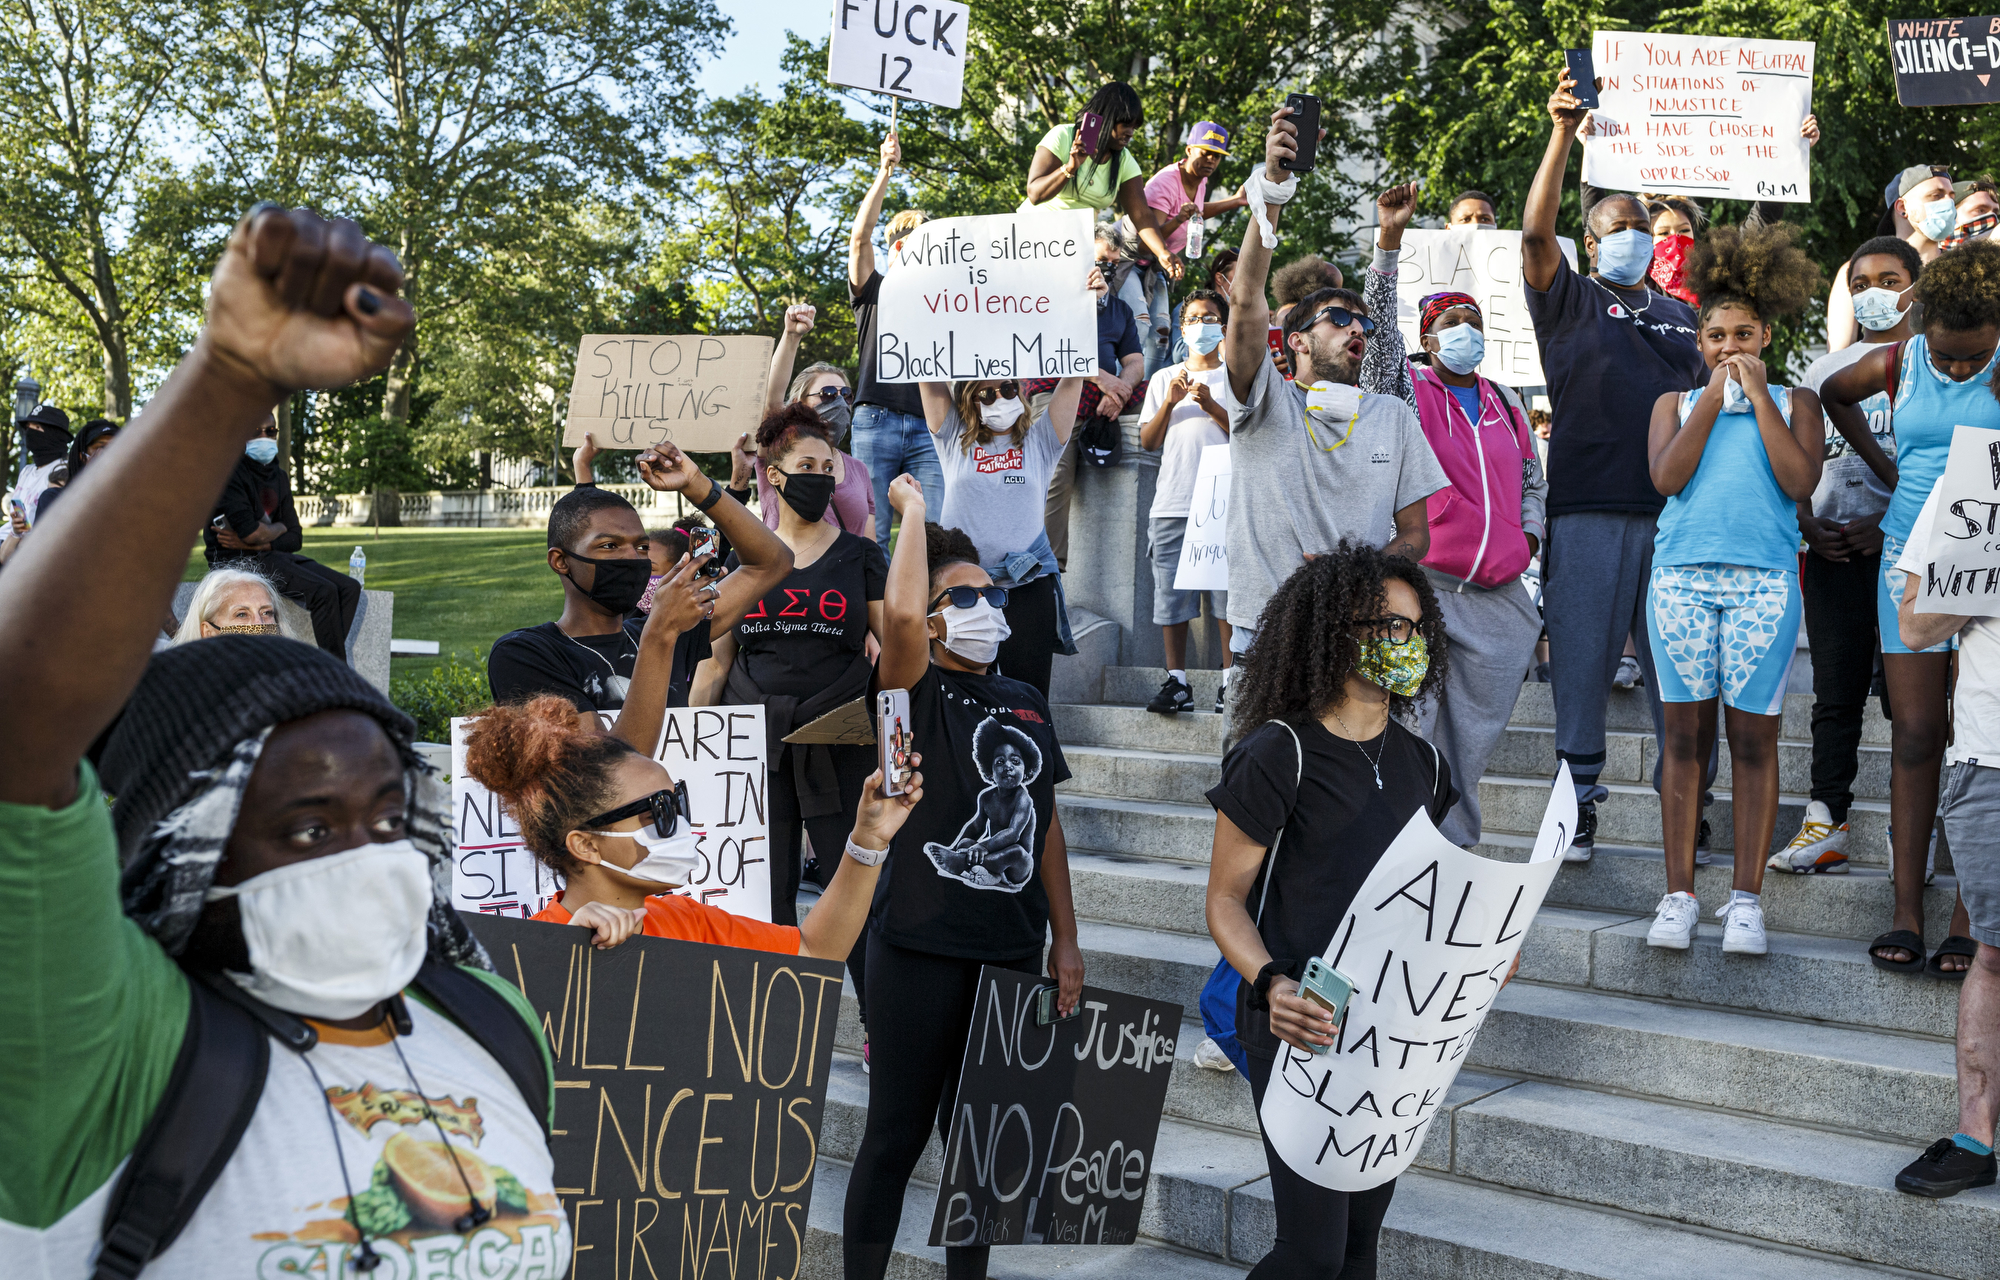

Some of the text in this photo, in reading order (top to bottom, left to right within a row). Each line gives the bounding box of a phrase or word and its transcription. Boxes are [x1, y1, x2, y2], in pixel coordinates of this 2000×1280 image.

[842, 0, 958, 57] FUCK
[878, 53, 913, 94] 12
[1605, 39, 1811, 73] IF YOU ARE NEUTRAL
[1601, 74, 1761, 93] IN SITUATIONS OF
[1649, 97, 1743, 112] INJUSTICE
[1597, 120, 1774, 138] YOU HAVE CHOSEN
[1609, 142, 1779, 159] THE SIDE OF THE
[1640, 165, 1733, 182] OPPRESSOR
[1757, 181, 1798, 197] BLM
[990, 223, 1077, 261] silence
[969, 266, 988, 285] is
[923, 287, 1050, 314] violence
[591, 338, 726, 378] STOP
[599, 377, 731, 420] KILLING
[979, 458, 1021, 472] PATRIOTIC
[741, 620, 844, 636] Delta Sigma Theta
[659, 710, 758, 761] ARE
[715, 762, 765, 827] IN
[718, 835, 765, 889] OF
[1374, 859, 1525, 948] ALL
[511, 943, 844, 1090] WILL NOT
[751, 1097, 816, 1200] US
[950, 1102, 1145, 1205] NO Peace
[940, 1191, 1010, 1246] Black
[1021, 1197, 1078, 1246] Lives
